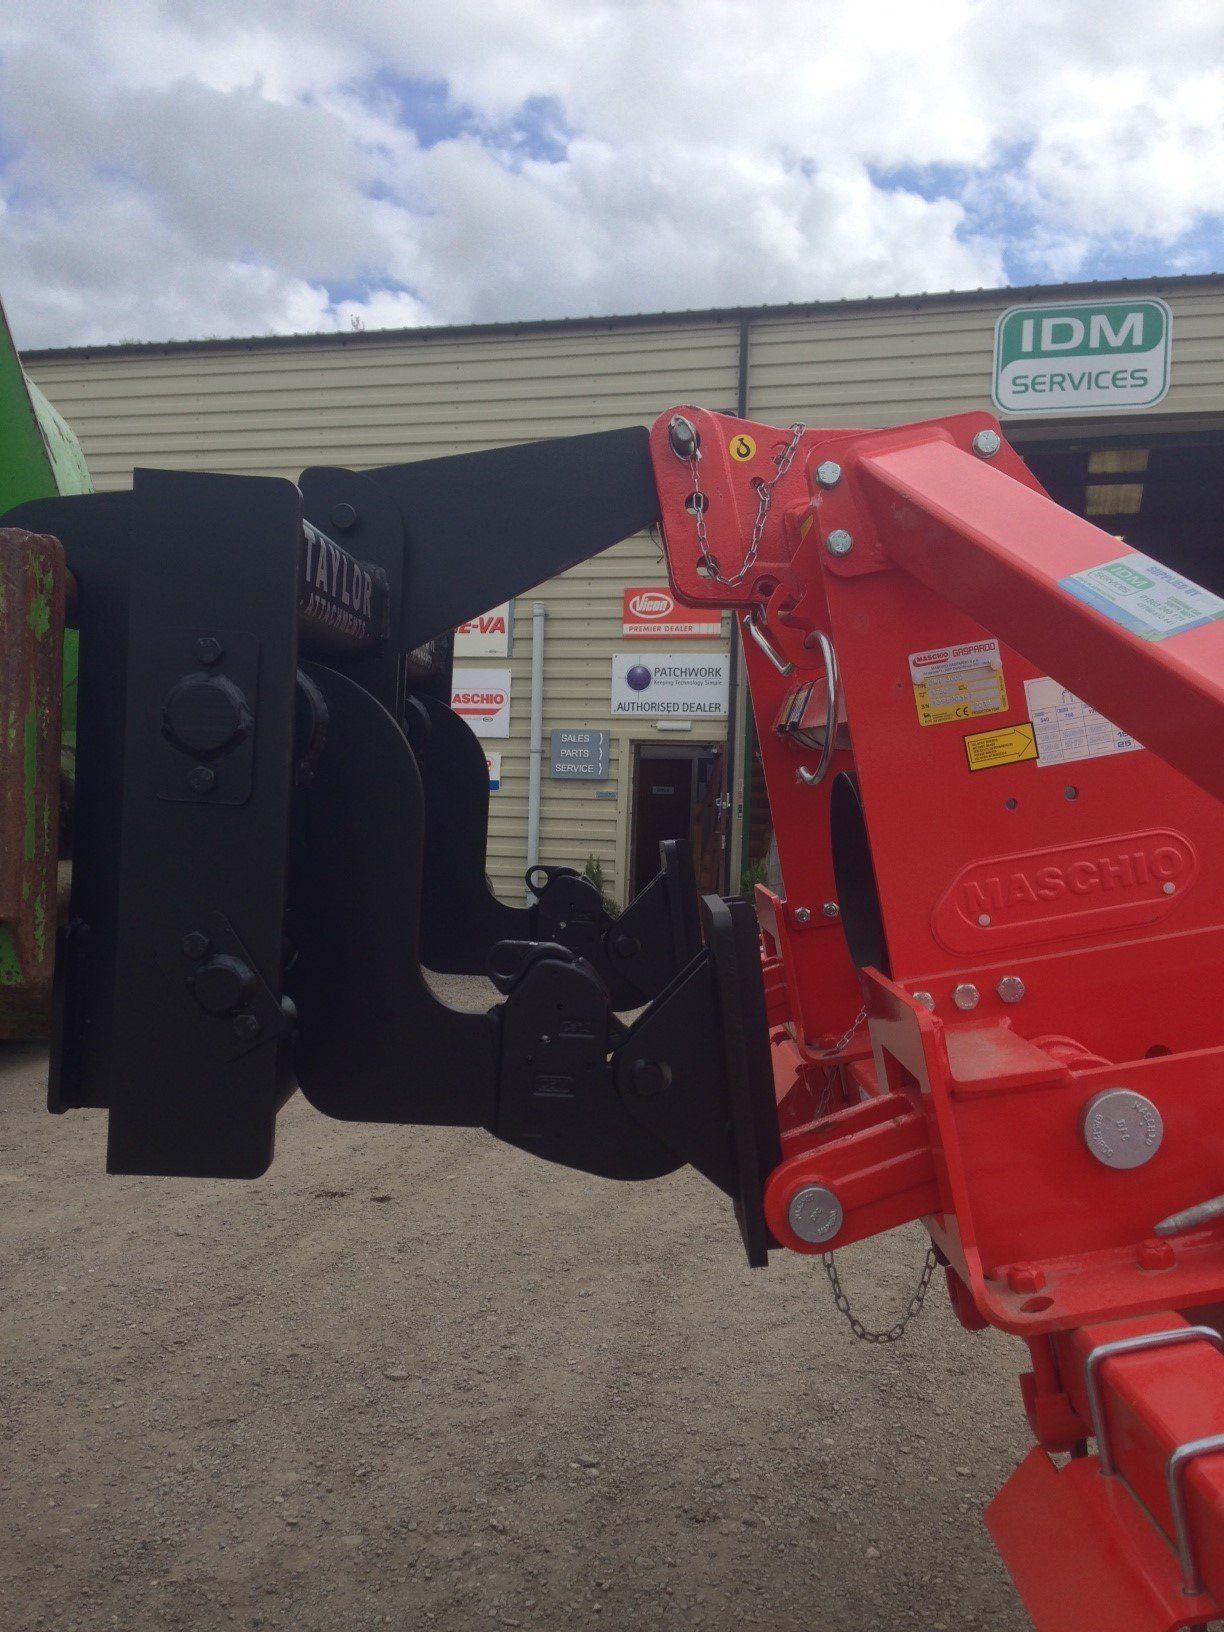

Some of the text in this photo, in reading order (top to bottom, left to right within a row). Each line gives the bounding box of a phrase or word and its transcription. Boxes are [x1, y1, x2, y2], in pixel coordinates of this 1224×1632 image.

[1020, 312, 1144, 353] IDM
[1011, 368, 1148, 395] SERVICES
[302, 519, 372, 619] TAYLOR
[1109, 565, 1148, 588] IDM
[1146, 566, 1189, 591] SUPPLIED
[454, 616, 506, 634] E-VA
[952, 642, 995, 658] GASPARDO
[654, 667, 722, 678] PATCHWORK
[452, 693, 504, 704] ASCHIO
[617, 702, 721, 713] AUTHORISED DEALER
[561, 734, 590, 743] SALES
[560, 750, 589, 758] PARTS
[555, 764, 594, 773] SERVICE
[963, 846, 1184, 914] MASCHIO
